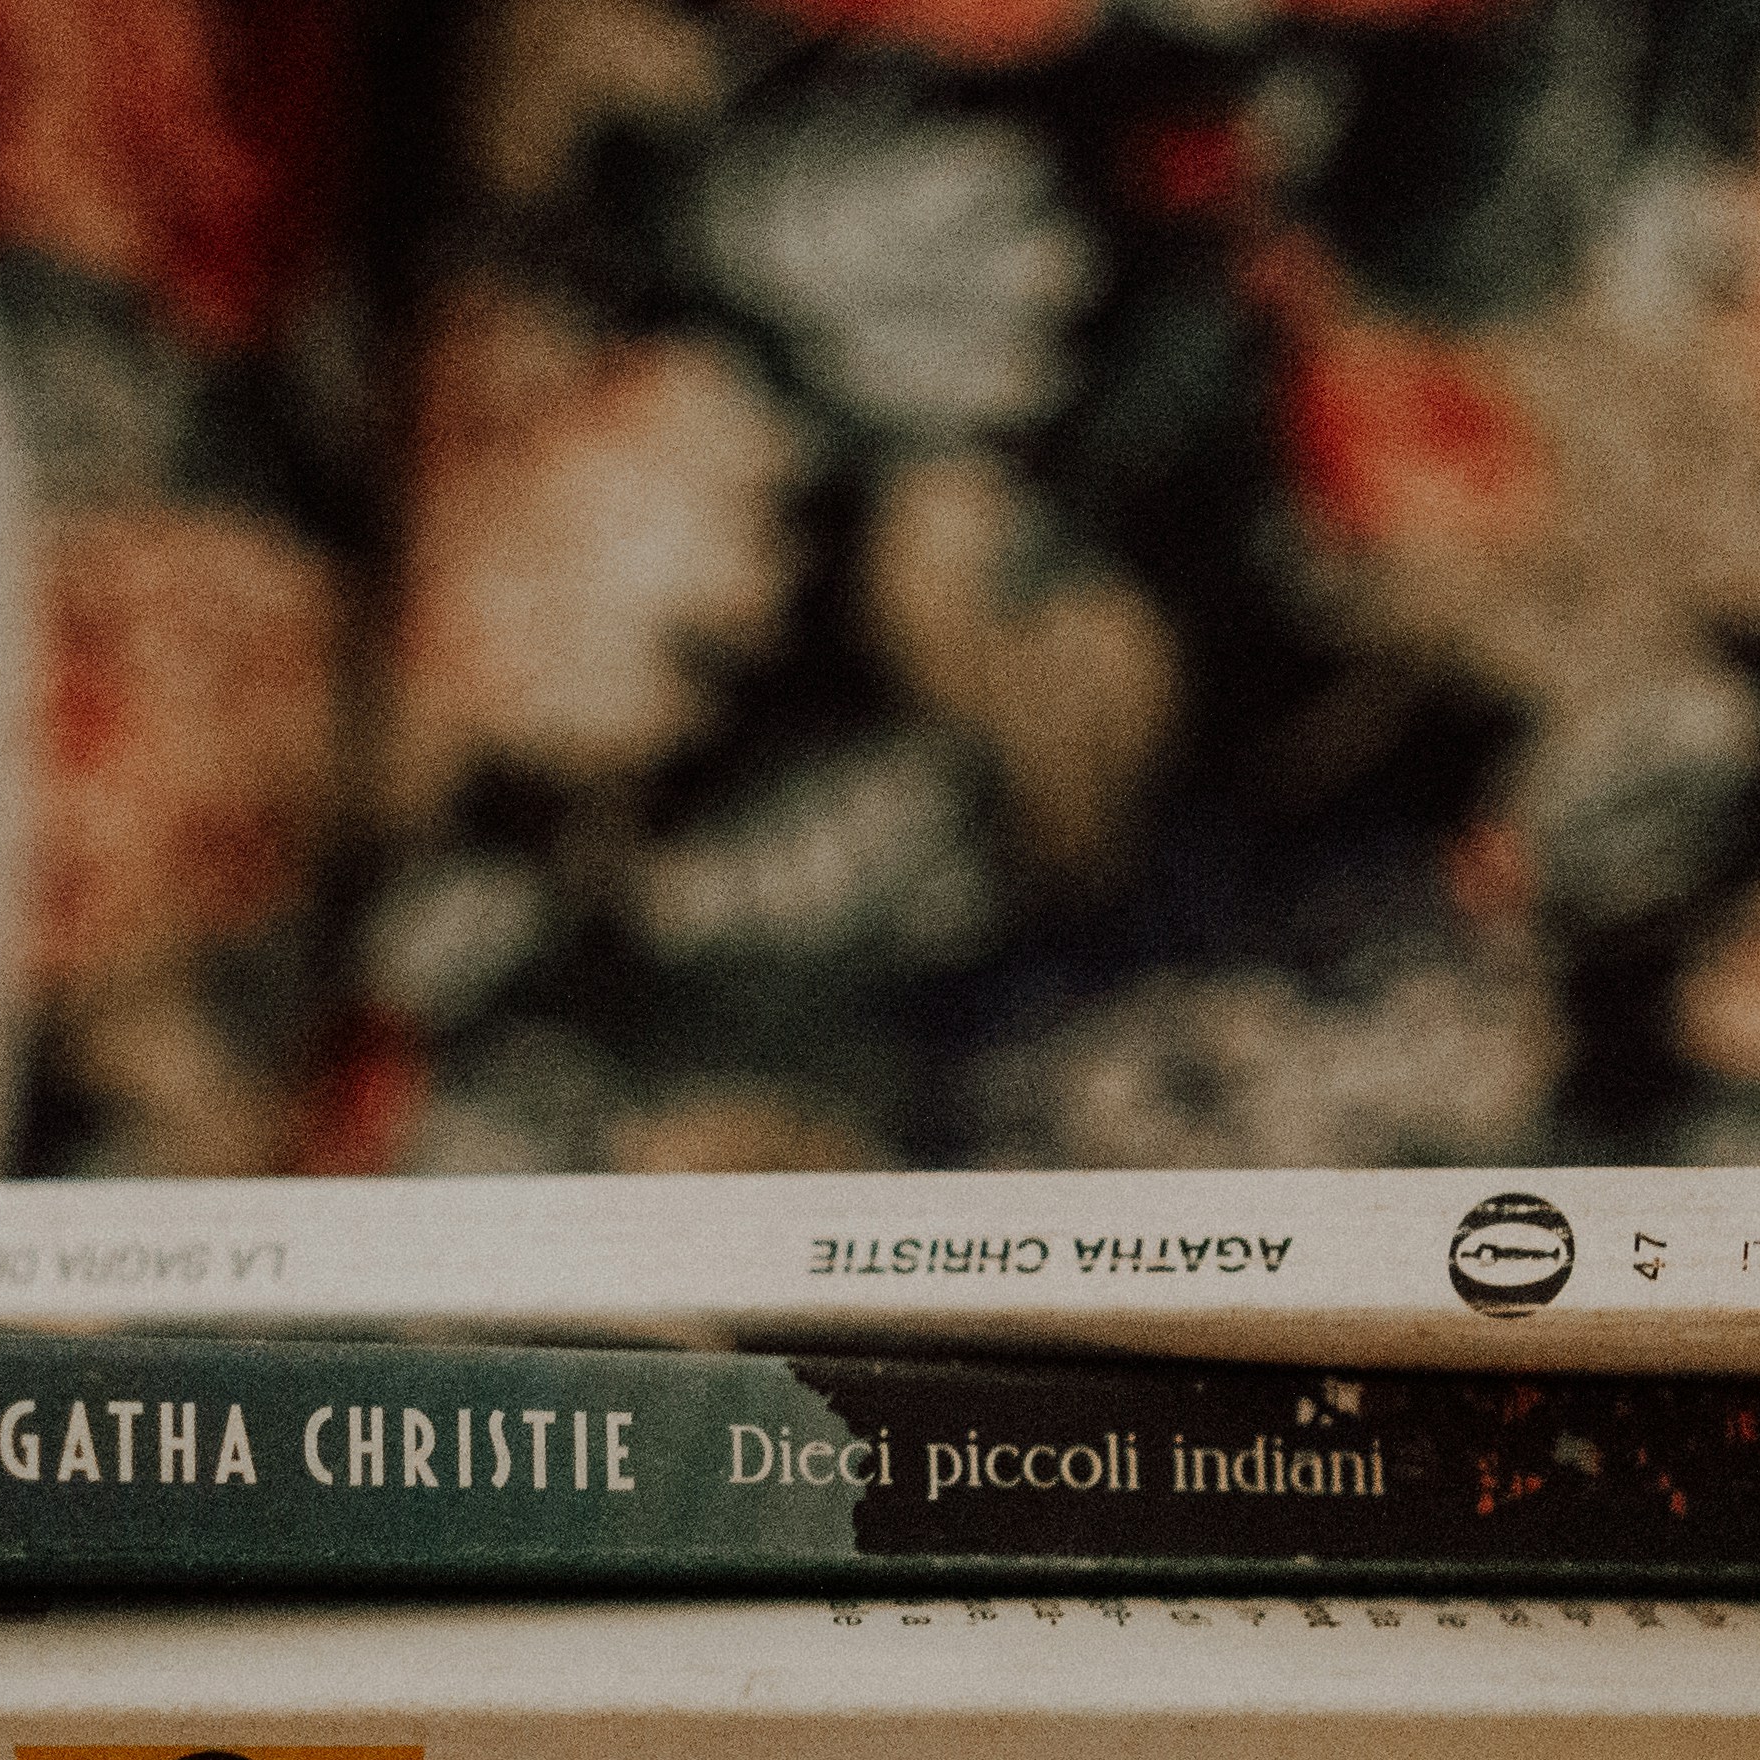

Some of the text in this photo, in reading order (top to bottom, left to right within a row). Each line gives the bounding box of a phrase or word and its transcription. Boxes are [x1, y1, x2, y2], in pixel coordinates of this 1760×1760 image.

[810, 1235, 1293, 1275] AGATHA CHRISTIE
[1632, 1230, 1668, 1282] 47
[302, 1403, 636, 1492] CHRISTIE
[727, 1424, 1385, 1501] Dieci piccoli indiani
